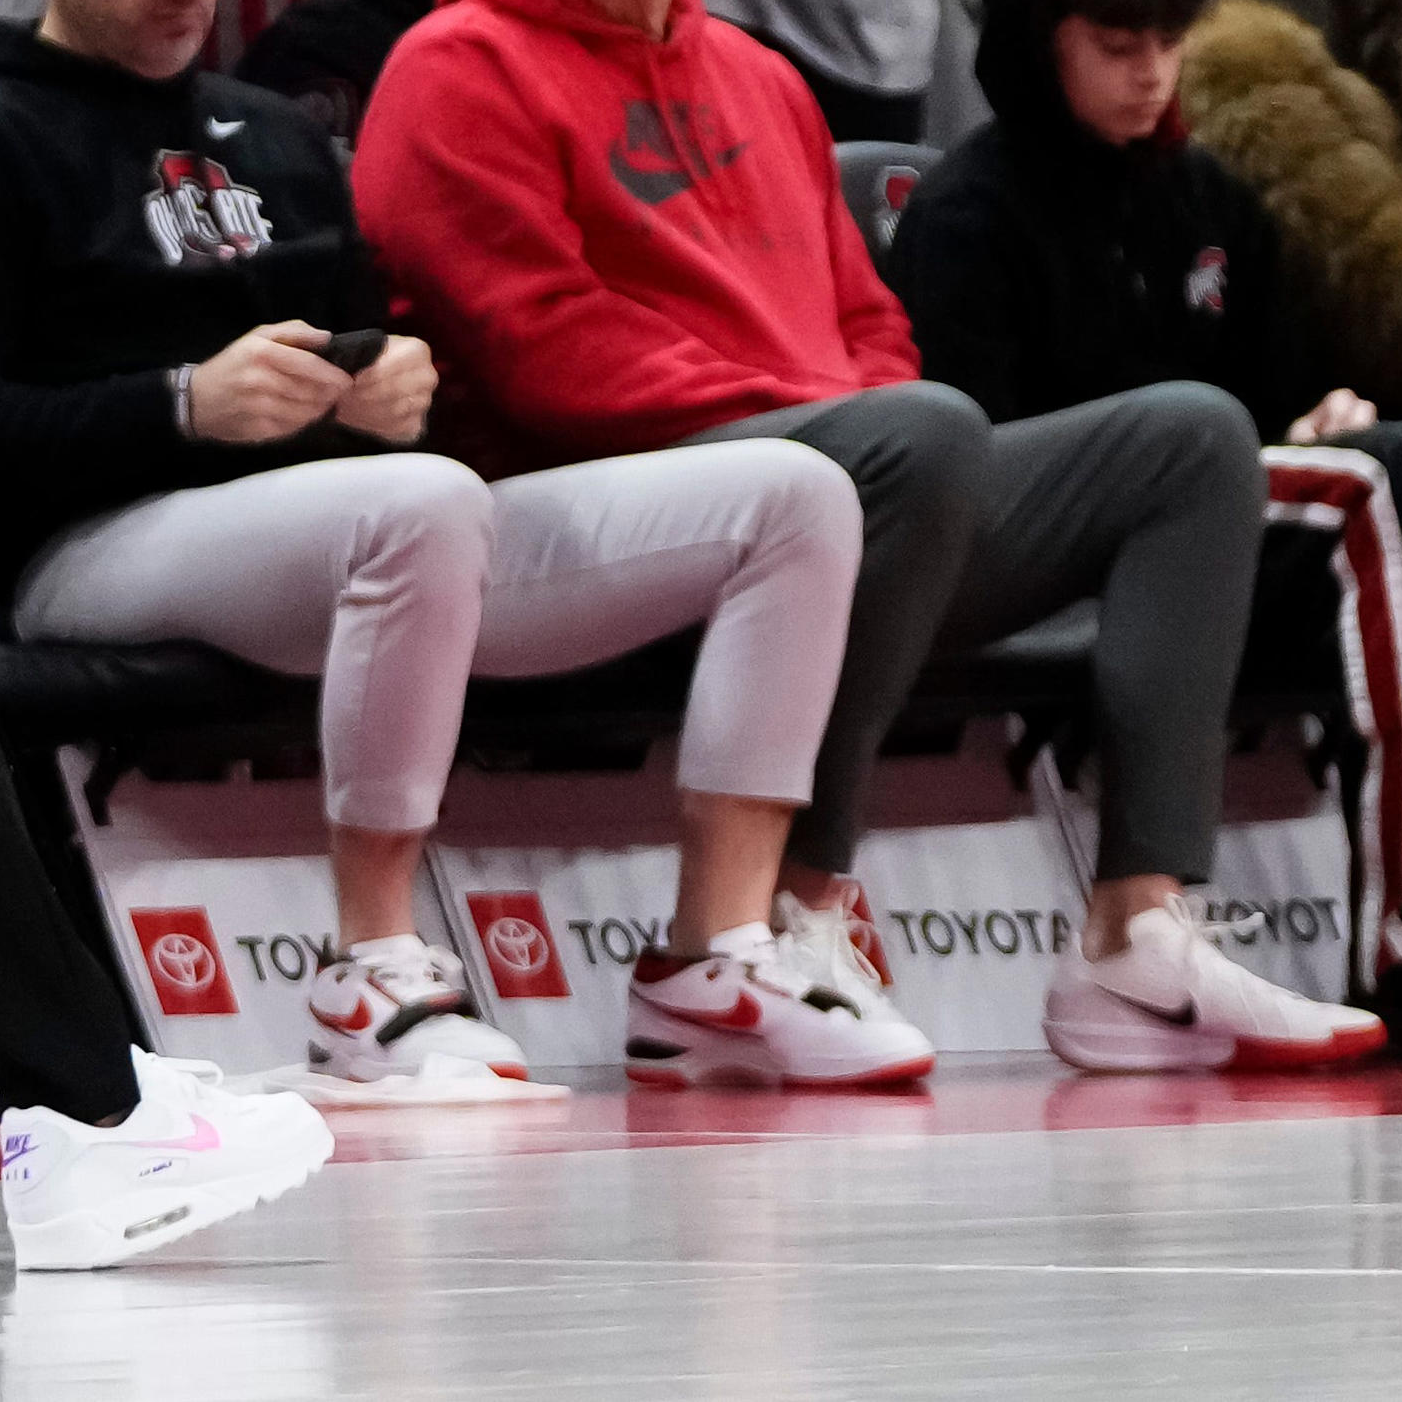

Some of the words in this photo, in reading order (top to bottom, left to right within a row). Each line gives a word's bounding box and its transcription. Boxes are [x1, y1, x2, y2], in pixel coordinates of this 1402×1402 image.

[566, 917, 660, 964] TOY
[887, 909, 1071, 955] TOYOTA
[236, 932, 332, 981] TOY
